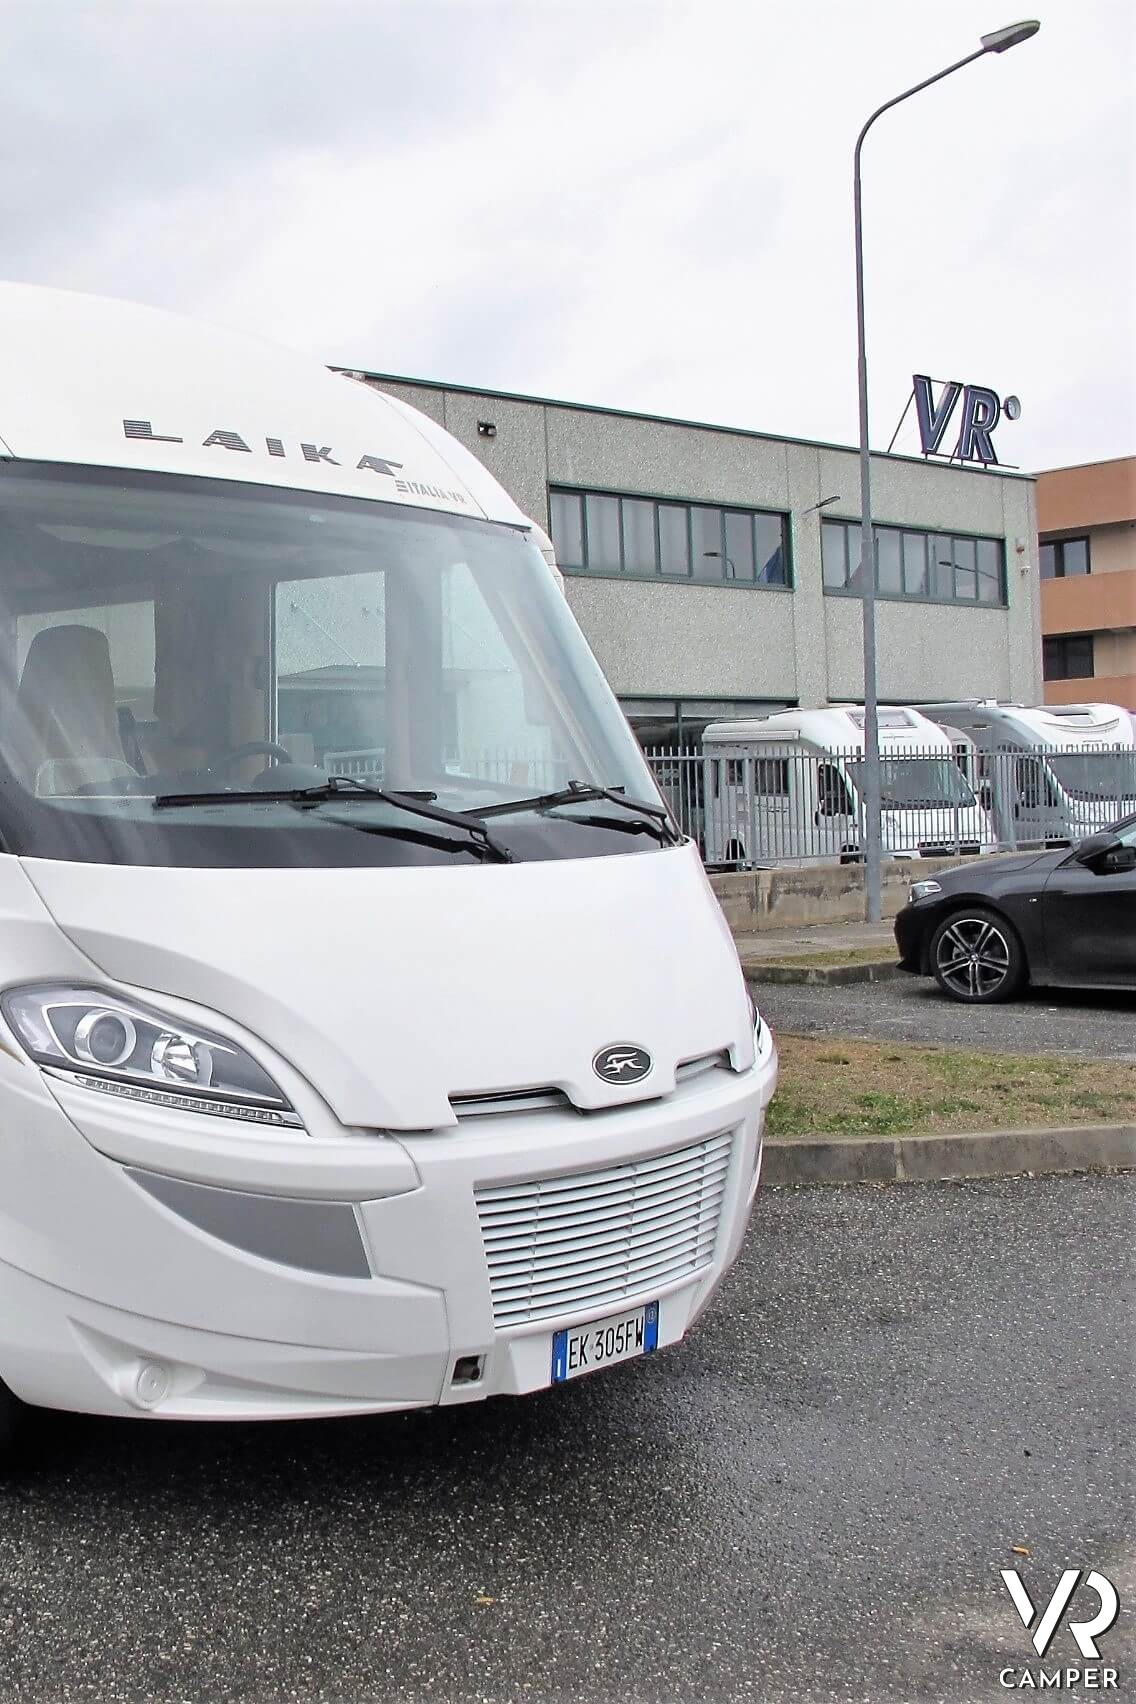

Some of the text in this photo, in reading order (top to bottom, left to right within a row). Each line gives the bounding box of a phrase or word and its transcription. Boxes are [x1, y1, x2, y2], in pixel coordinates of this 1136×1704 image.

[122, 419, 404, 477] LAIKA
[568, 1316, 644, 1370] EK 305FW
